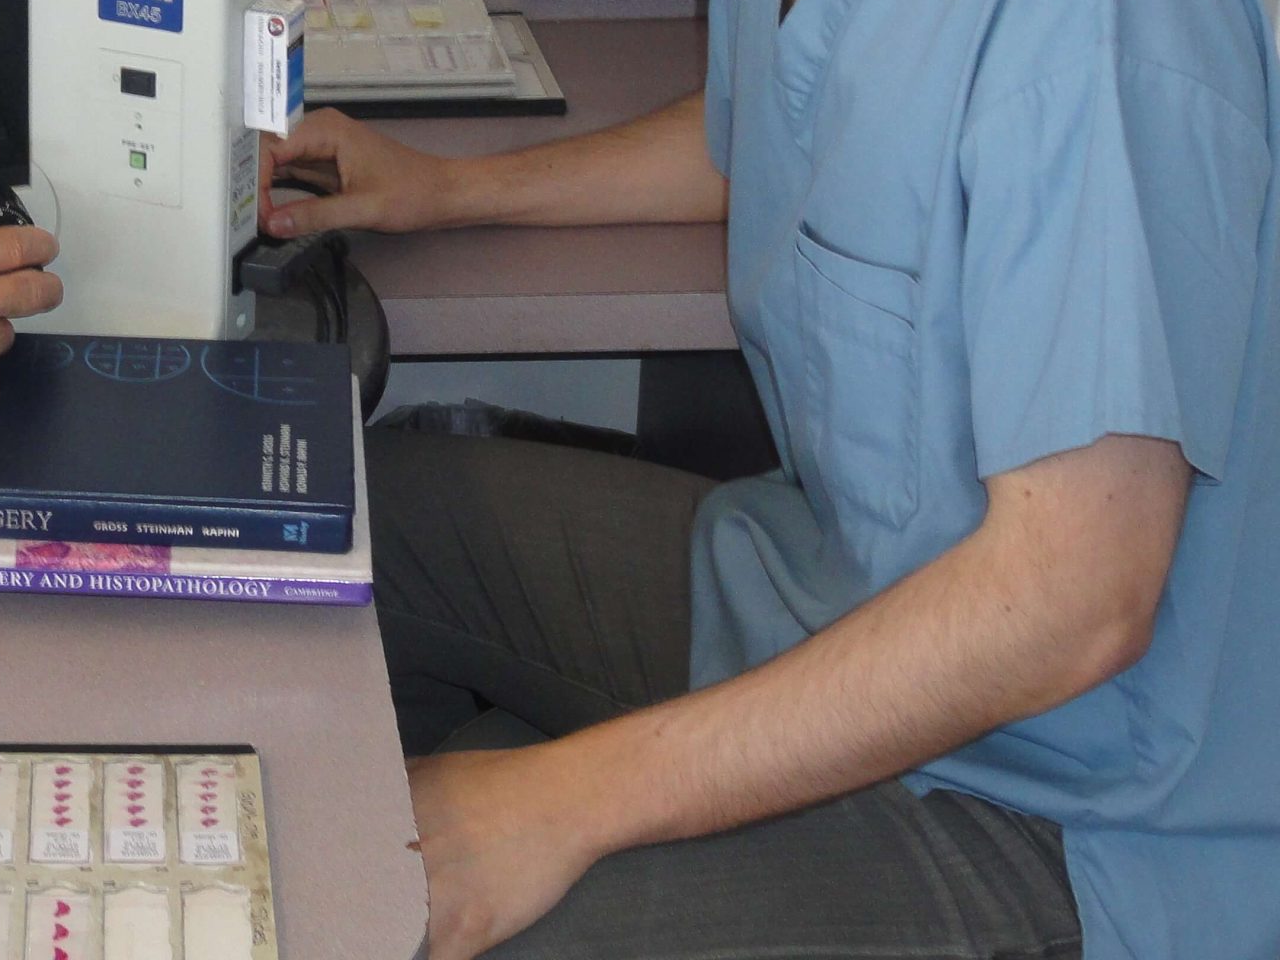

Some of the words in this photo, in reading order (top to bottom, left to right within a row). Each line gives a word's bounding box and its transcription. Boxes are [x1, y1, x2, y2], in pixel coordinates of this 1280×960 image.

[116, 0, 162, 24] BX45
[93, 520, 128, 532] GROSS
[135, 522, 194, 536] STEINMAN
[201, 525, 240, 538] RAPINI
[39, 573, 83, 589] AND
[89, 574, 271, 598] HISTOPATHOLOGY
